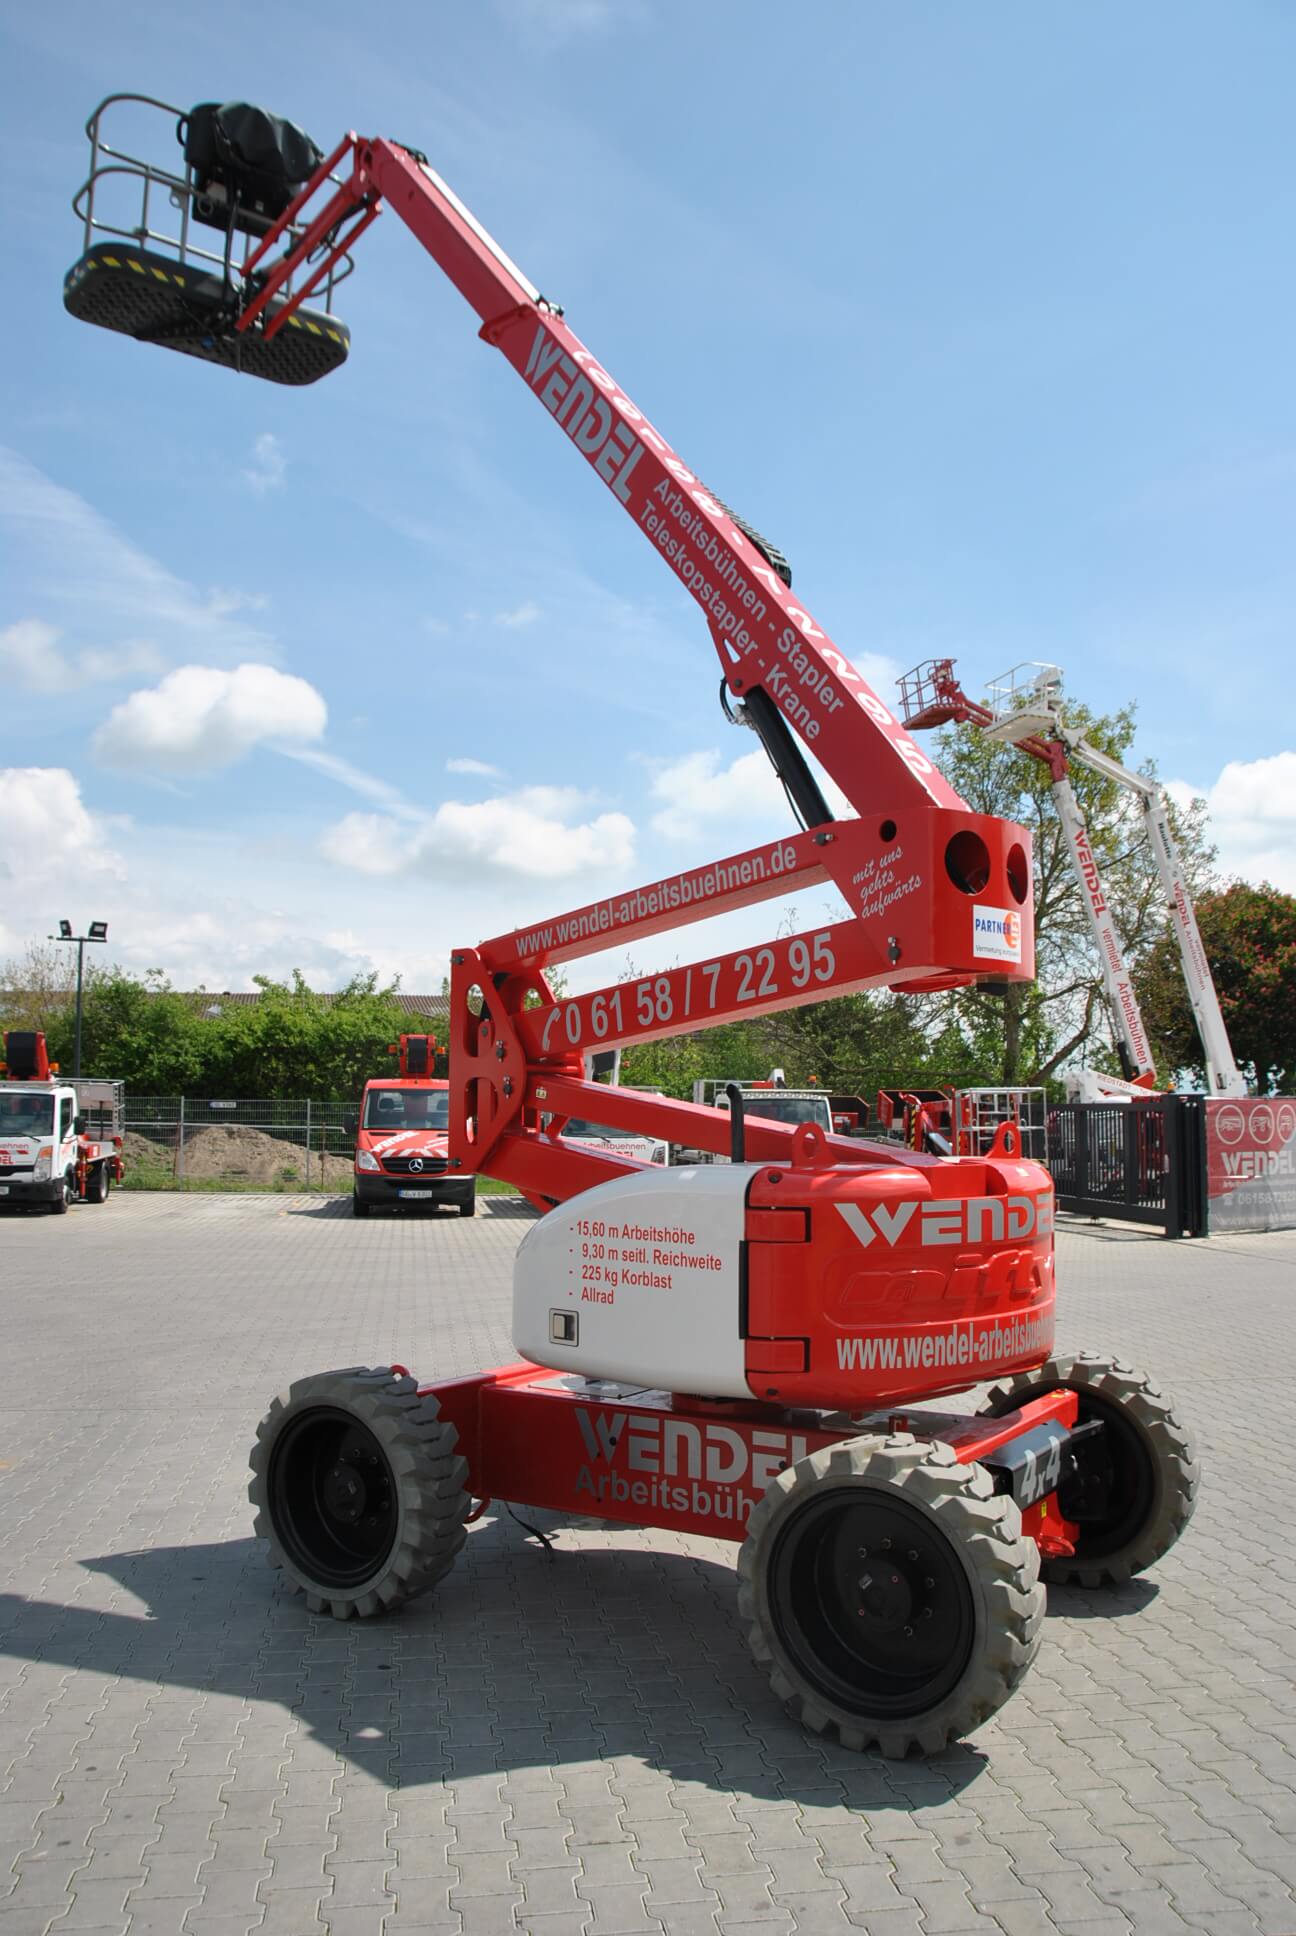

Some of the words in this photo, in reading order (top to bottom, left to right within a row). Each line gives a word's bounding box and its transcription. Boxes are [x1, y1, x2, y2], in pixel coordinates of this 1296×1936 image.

[524, 324, 645, 503] WENDEL
[654, 478, 768, 622] Arbeitsbühnen
[776, 627, 845, 714] Stapler
[639, 499, 759, 656] Teleskopstapler
[765, 663, 821, 740] Krane
[852, 859, 875, 885] mit
[879, 846, 904, 871] uns
[1073, 830, 1108, 919] WENDEL
[515, 842, 797, 958] www.wendel-arbeitsbuehnen.de
[860, 869, 895, 905] gehts
[861, 875, 922, 919] aufwärts
[975, 918, 1011, 936] PARTNER
[565, 1003, 581, 1044] 0
[591, 990, 623, 1037] 61
[636, 978, 674, 1026] 58
[703, 963, 721, 1009] 7
[734, 949, 778, 1002] 22
[788, 932, 836, 988] 95
[1221, 1150, 1296, 1177] WENDEL
[577, 1220, 605, 1238] 15,60
[608, 1226, 619, 1239] m
[621, 1223, 695, 1245] Arbeitshöhe
[581, 1264, 601, 1281] 225
[604, 1267, 618, 1287] kg
[621, 1269, 673, 1289] Korblast
[582, 1243, 605, 1259] 9,30
[608, 1248, 618, 1261] m
[622, 1247, 649, 1264] seitl.
[653, 1248, 722, 1271] Reichweite
[581, 1287, 614, 1304] Allrad
[1020, 1435, 1060, 1504] 4x4
